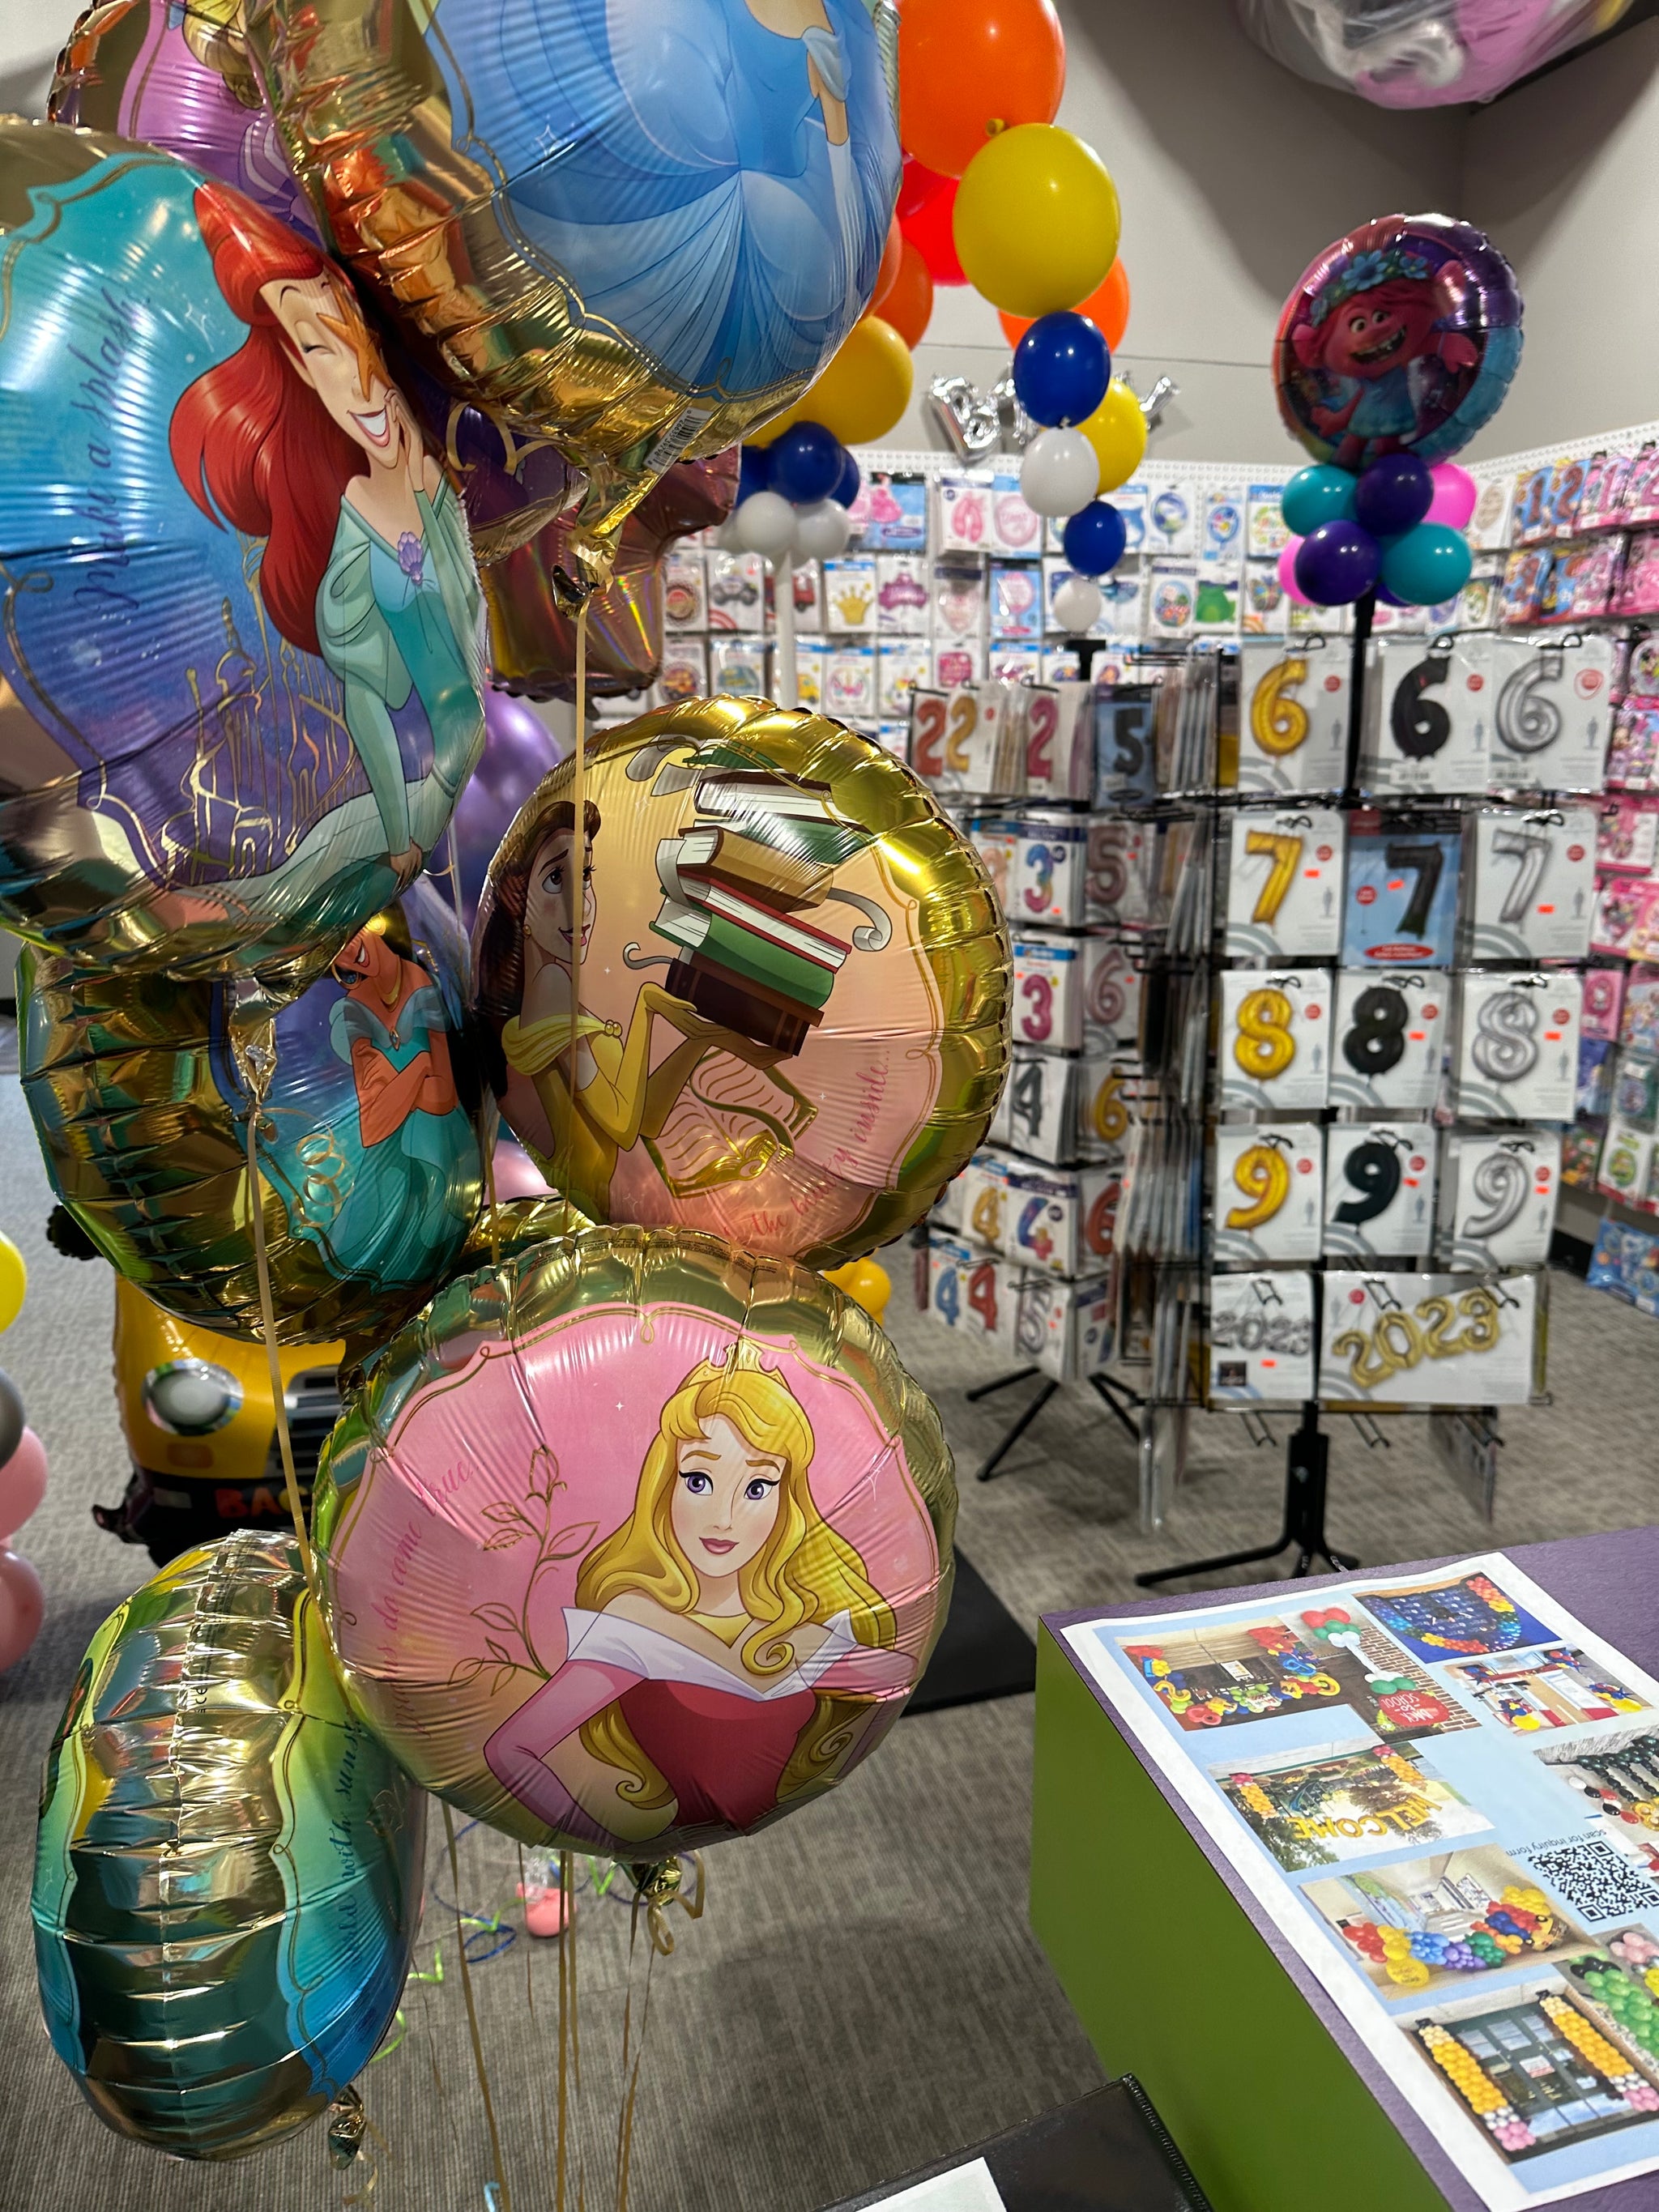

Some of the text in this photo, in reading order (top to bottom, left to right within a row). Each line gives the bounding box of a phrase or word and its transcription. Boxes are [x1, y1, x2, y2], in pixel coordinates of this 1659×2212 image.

[1251, 657, 1308, 756] 6
[1392, 655, 1451, 761] 6
[1495, 655, 1564, 753] 6
[1245, 829, 1304, 925] 7
[1385, 842, 1444, 940] 7
[1491, 829, 1553, 923] 7
[1234, 989, 1295, 1081] 8
[1342, 987, 1409, 1076] 8
[1472, 991, 1537, 1082] 8
[1224, 1144, 1290, 1230] 9
[1331, 1141, 1401, 1224] 9
[1461, 1153, 1529, 1238] 9
[1332, 1287, 1499, 1388] 2023
[1286, 1793, 1443, 1840] WELCOME
[1506, 1829, 1607, 1856] scan for inquiry form
